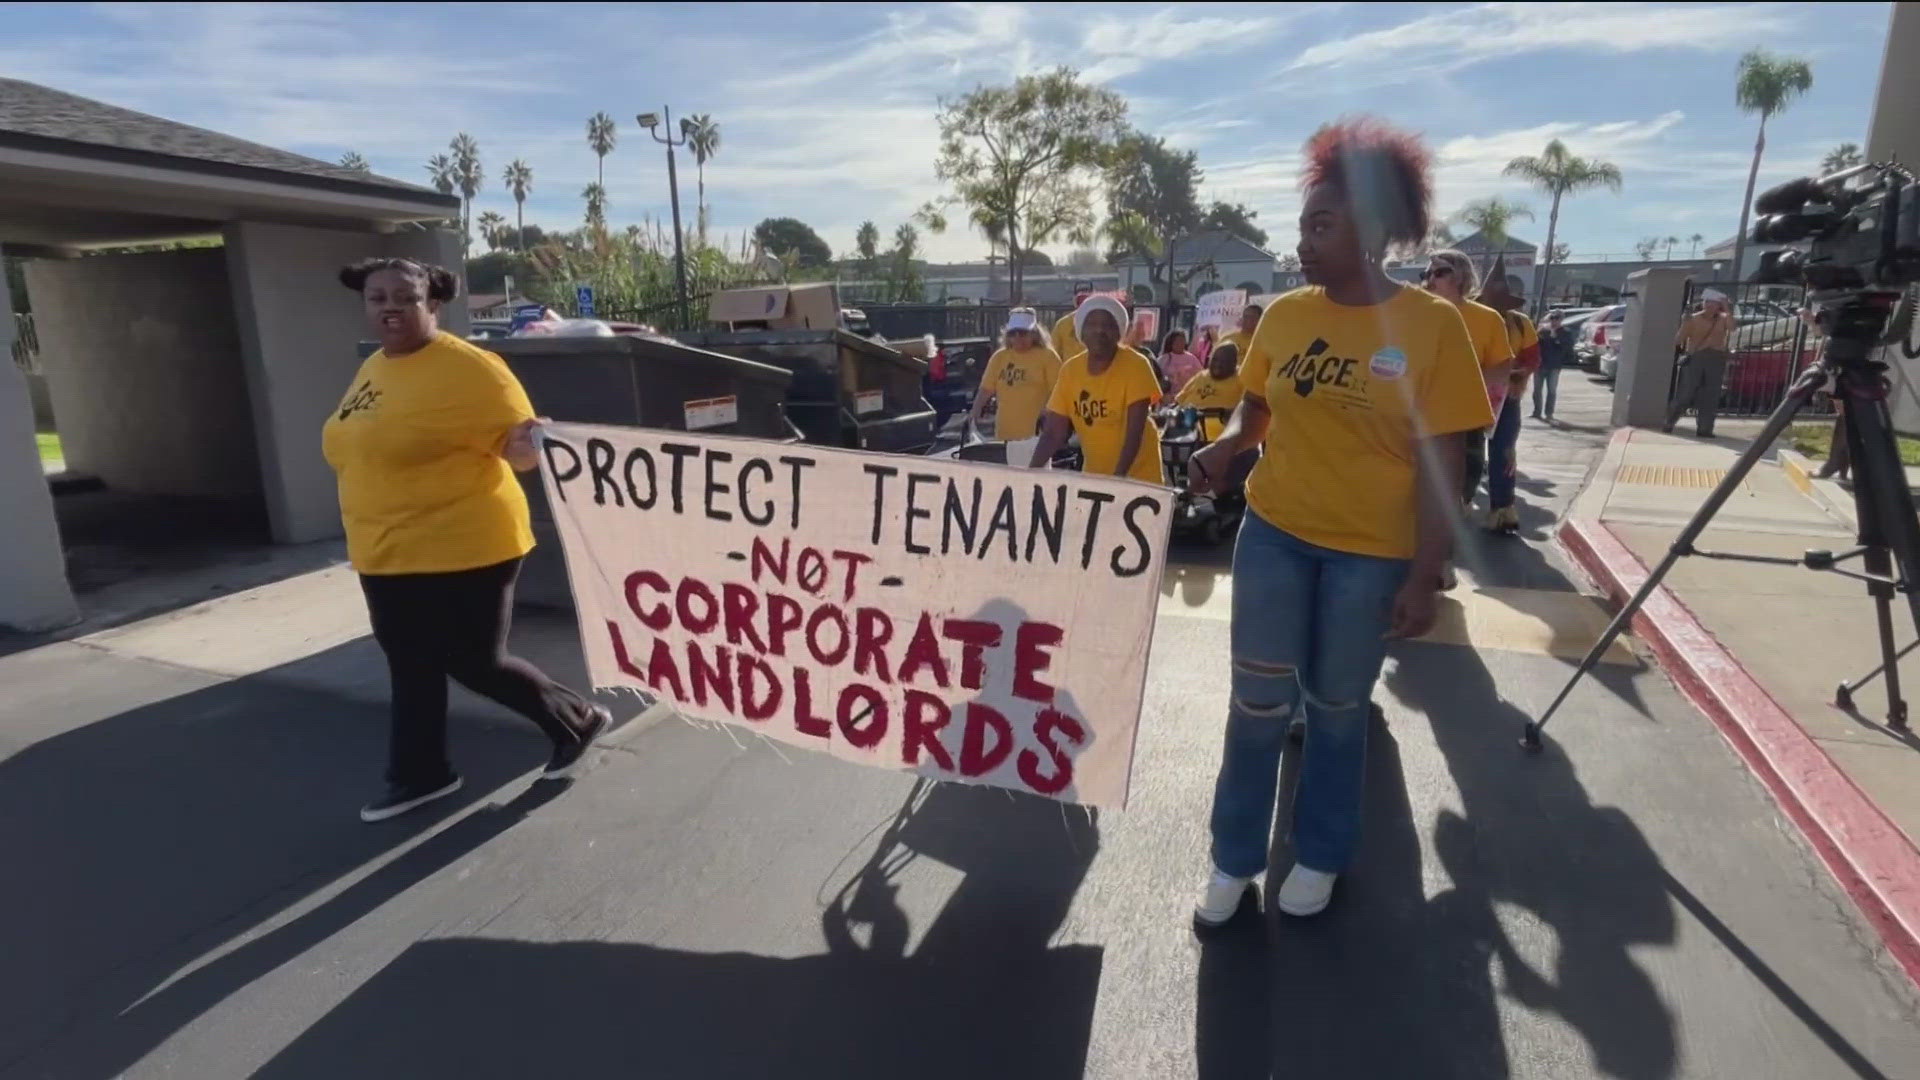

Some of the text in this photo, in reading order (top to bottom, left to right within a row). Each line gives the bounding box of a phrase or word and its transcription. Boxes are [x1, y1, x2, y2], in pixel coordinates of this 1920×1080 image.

[543, 437, 1161, 578] PROTECT TENANTS
[624, 569, 1064, 703] CORPORATE
[606, 619, 1086, 795] LANDLORDS
